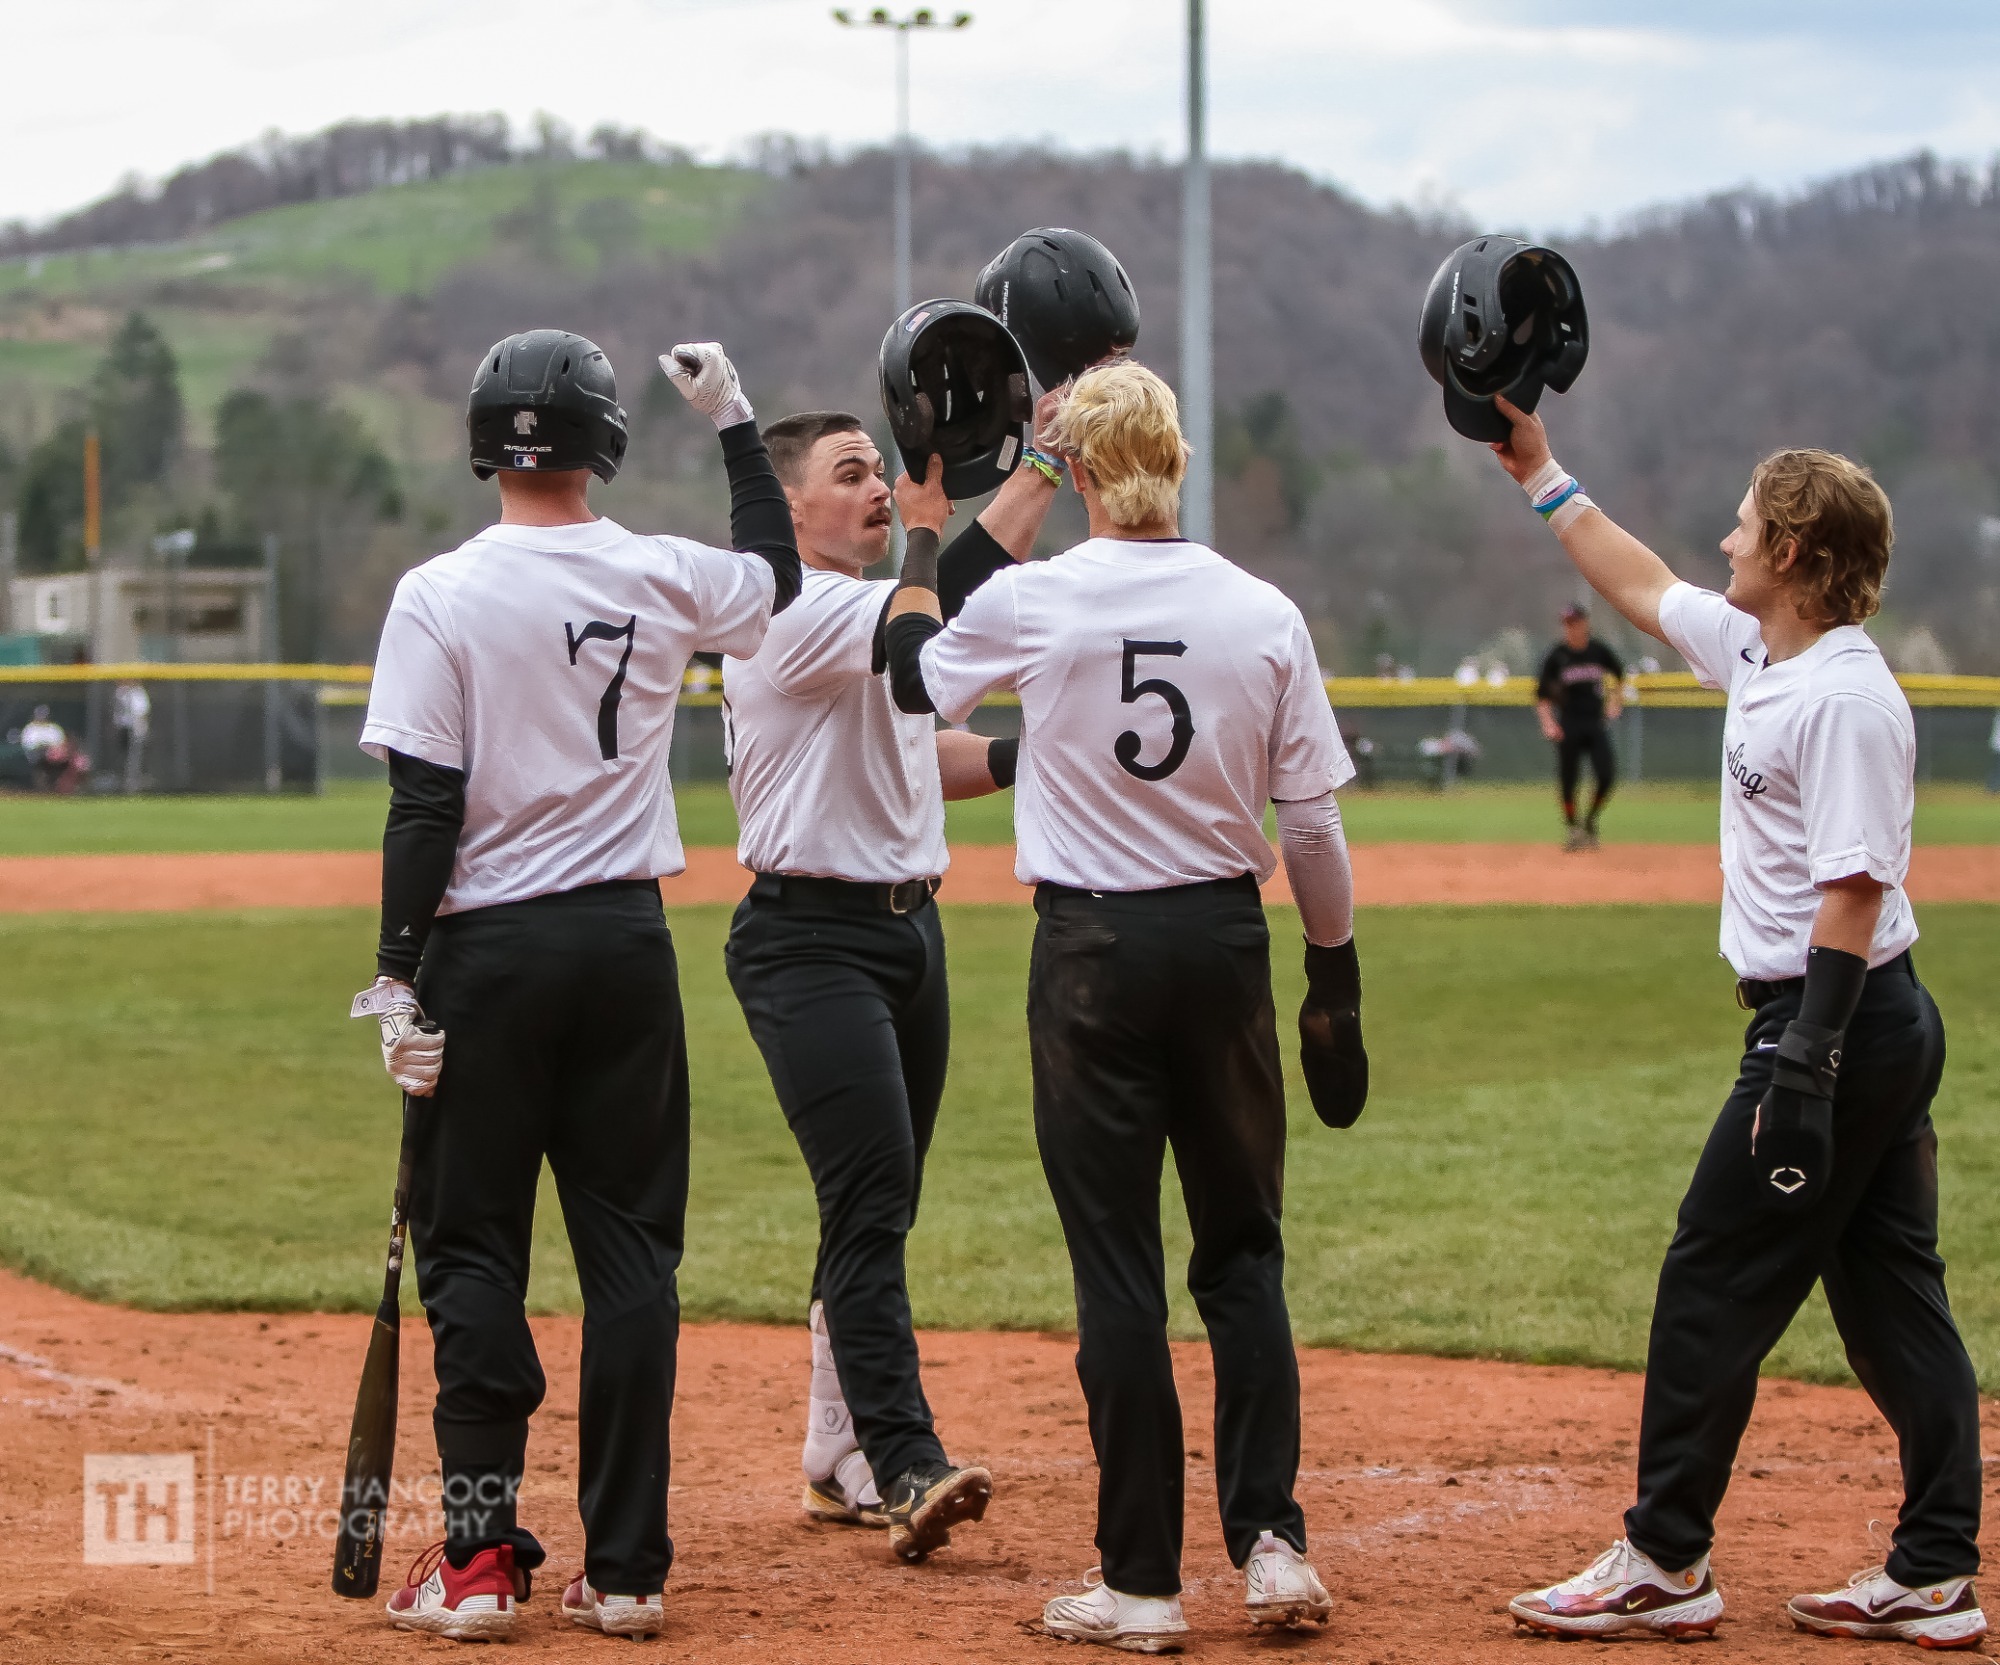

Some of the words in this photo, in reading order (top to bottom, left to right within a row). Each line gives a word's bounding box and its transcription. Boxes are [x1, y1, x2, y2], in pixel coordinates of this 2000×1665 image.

[503, 444, 552, 453] RAWLINGS
[565, 615, 636, 761] 7
[1114, 638, 1196, 782] 5
[1725, 742, 1768, 800] eling
